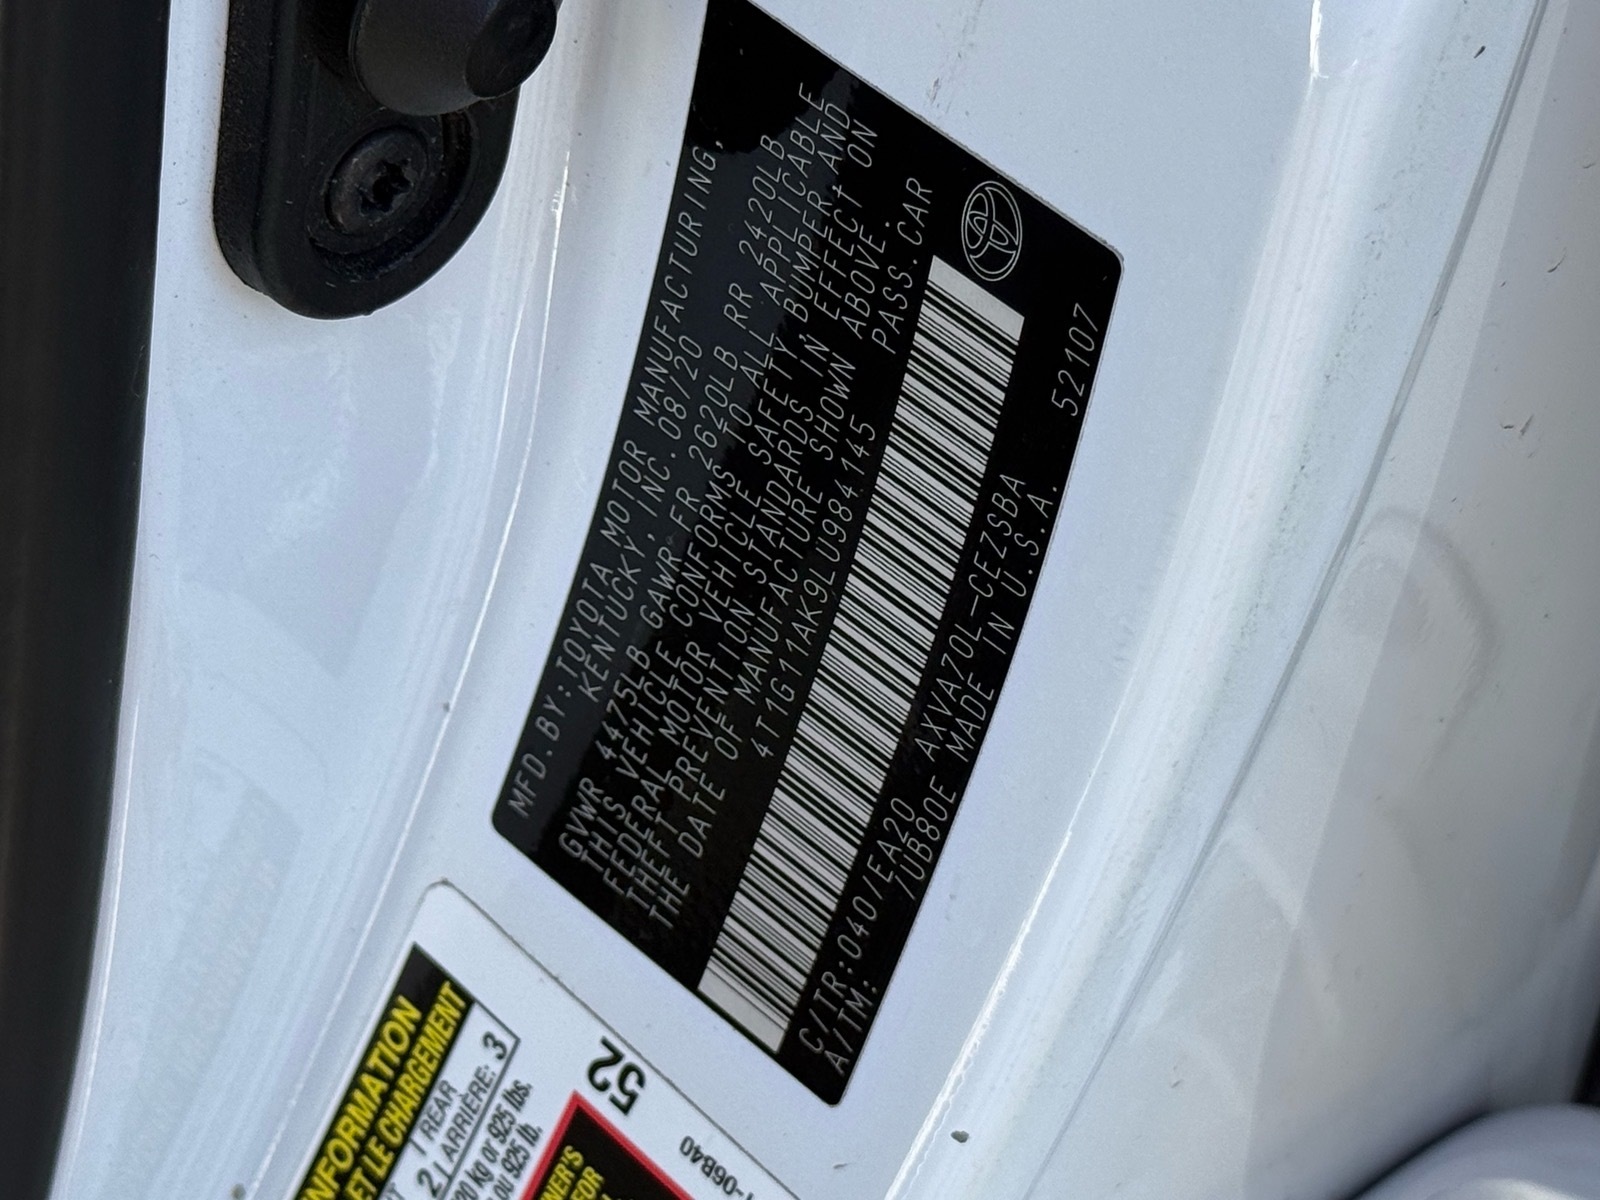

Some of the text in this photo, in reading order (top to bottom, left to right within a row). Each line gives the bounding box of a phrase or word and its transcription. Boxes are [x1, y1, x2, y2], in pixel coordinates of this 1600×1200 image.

[600, 440, 646, 547] MOTOR
[633, 141, 723, 426] MANUFACTURING,
[558, 135, 784, 858] GVWR 4475LB GAWR FR 2620LB RR 2420LB
[578, 335, 702, 702] KENTUCKY, INC. 08/20
[581, 82, 824, 872] THIS VEHICLE CONFORMS TO ALL APPLICABLE
[603, 766, 672, 895] FEDERAL
[659, 641, 710, 746] MOTOR
[699, 480, 761, 623] VEHICLE
[817, 103, 850, 175] AND
[626, 119, 877, 909] THEFT PREVENTION STANDARDS IN EFFECT ON
[650, 222, 890, 928] THE DATE OF MANUFACTURE SHOWN ABOVE.
[914, 474, 1026, 763] AXVA70L-CEZSBA
[1051, 303, 1099, 416] 52107
[751, 414, 875, 757] 4T1G11AK9LU984145
[823, 487, 1058, 1076] A/TM: /UB80E MADE IN U.S.A.
[301, 994, 421, 1200] NFORMATION
[361, 1136, 395, 1179] LE
[376, 981, 465, 1144] CHARGEMENT
[417, 1031, 508, 1198] 2 ARRIÈRE: 3
[420, 1079, 458, 1141] REAR
[482, 1138, 500, 1165] or
[487, 1103, 517, 1145] 925
[493, 1122, 542, 1200] ou 925 lb.
[502, 1080, 533, 1112] lbs.
[587, 1036, 645, 1116] 52
[464, 1161, 494, 1187] kg
